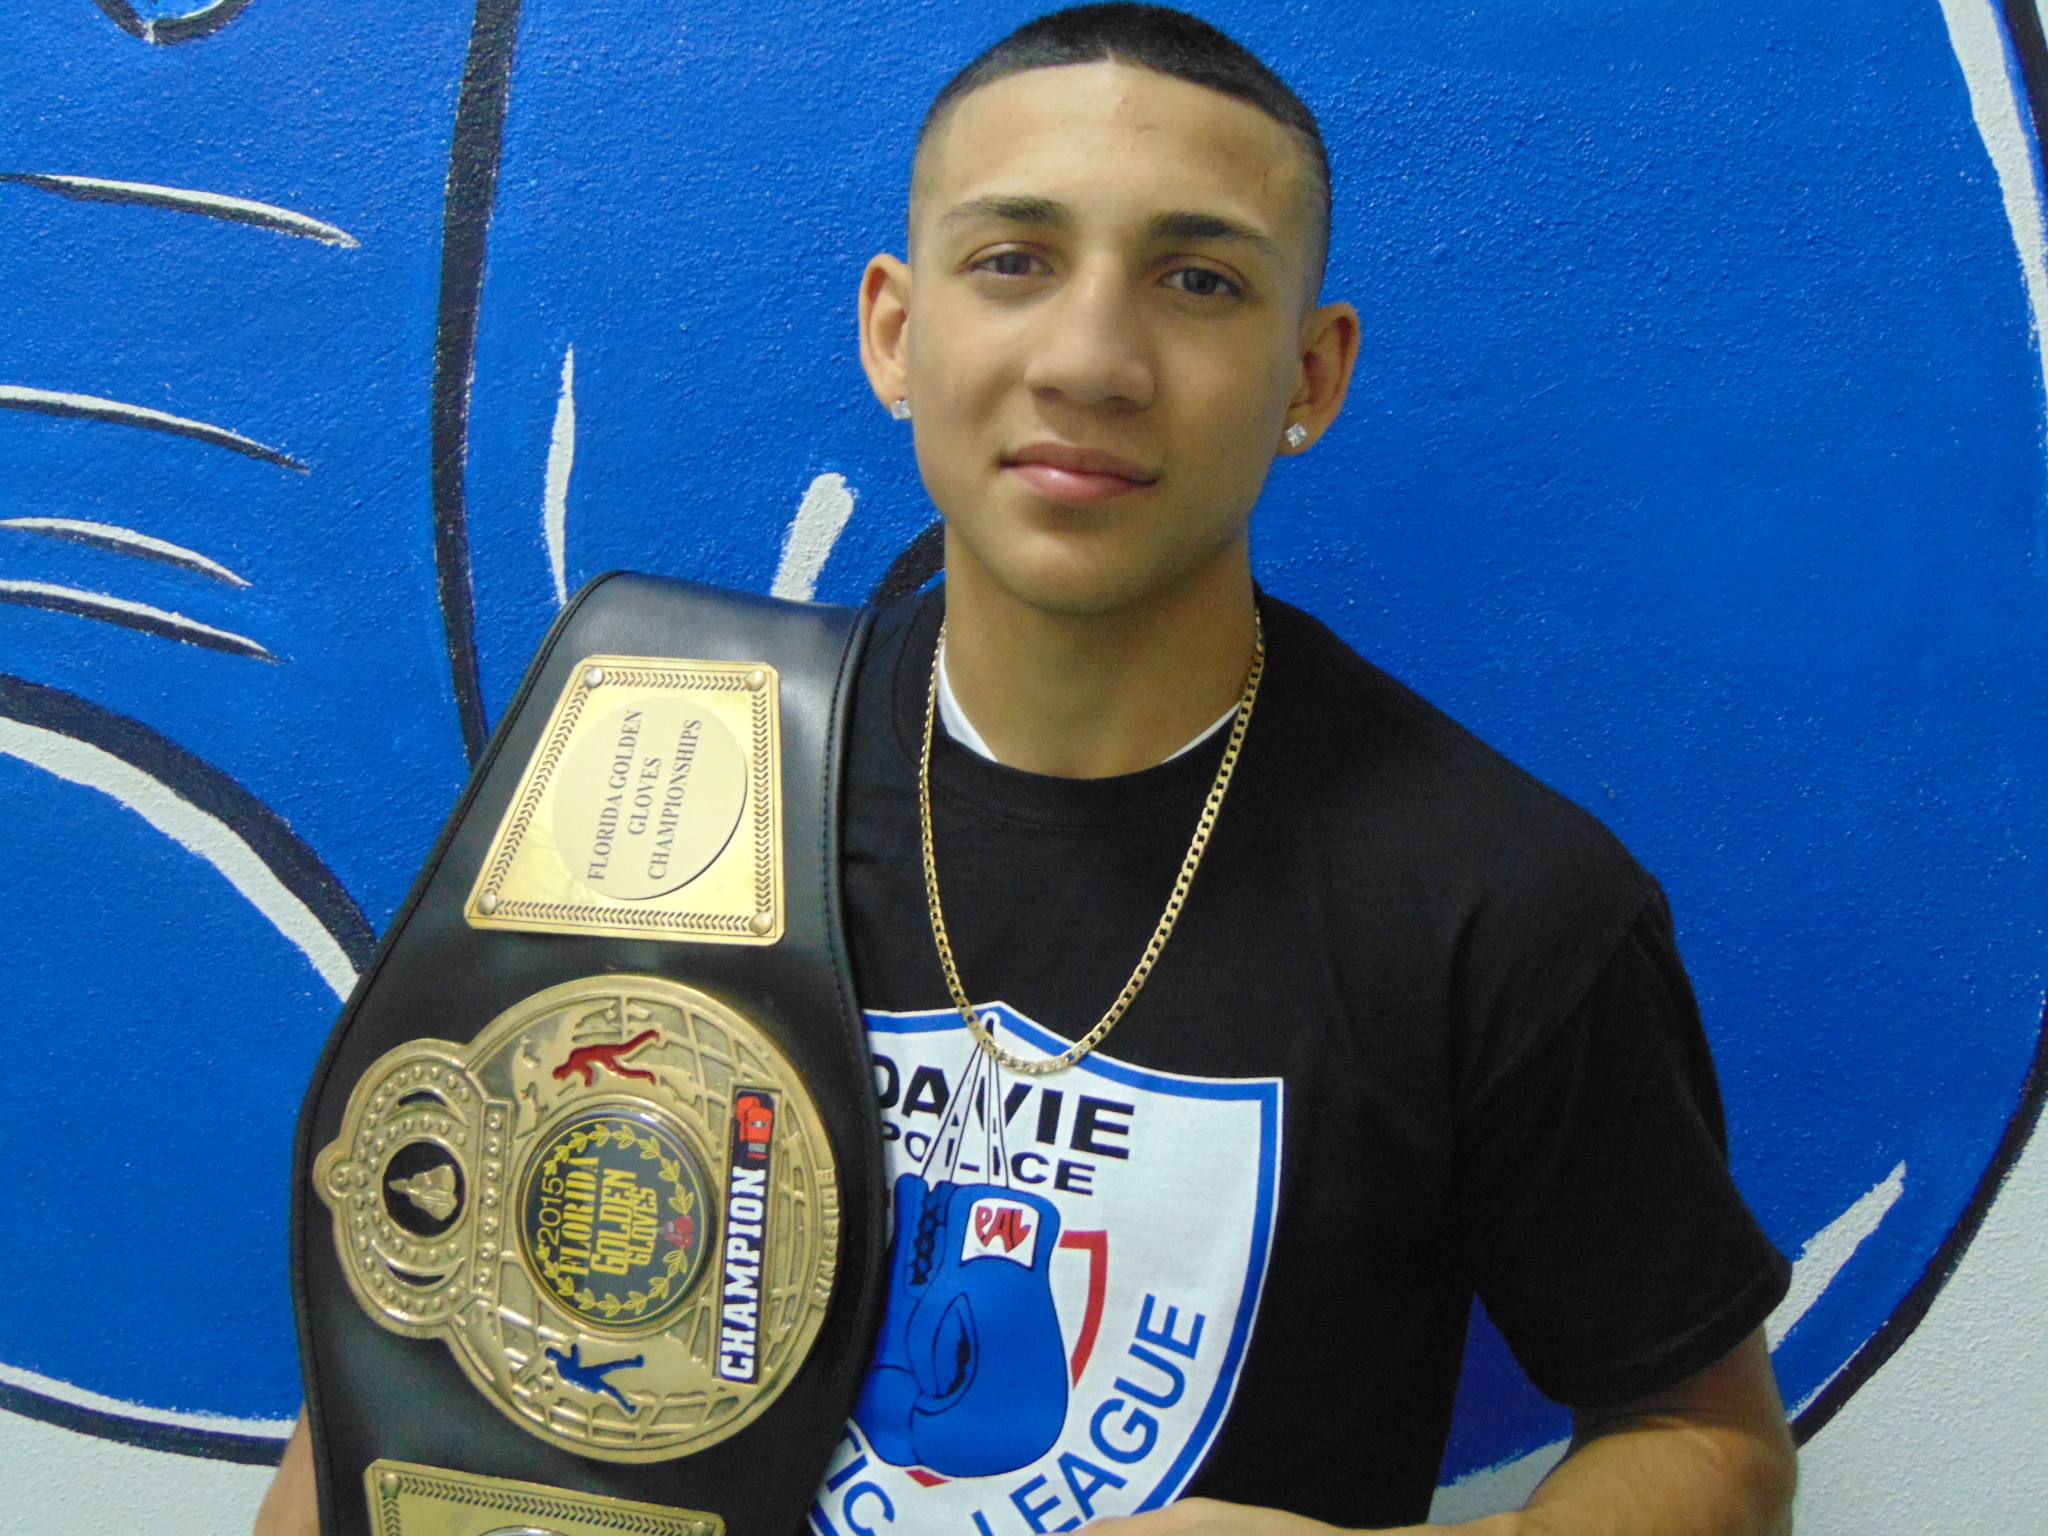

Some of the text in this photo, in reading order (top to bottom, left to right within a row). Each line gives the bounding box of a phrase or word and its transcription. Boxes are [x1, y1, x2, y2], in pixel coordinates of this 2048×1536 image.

[587, 710, 644, 881] FLORIDA GOLDEN
[628, 757, 662, 835] GLOVES
[647, 719, 702, 880] CHAMPIONSHIPS
[537, 1177, 564, 1246] 2015
[559, 1156, 599, 1275] FLORIDA
[591, 1168, 638, 1276] GOLDEN
[627, 1187, 658, 1267] GLOVES
[813, 1167, 840, 1305] RINGSIDE
[975, 1205, 1032, 1253] PAL
[720, 1166, 767, 1380] CHAMPION
